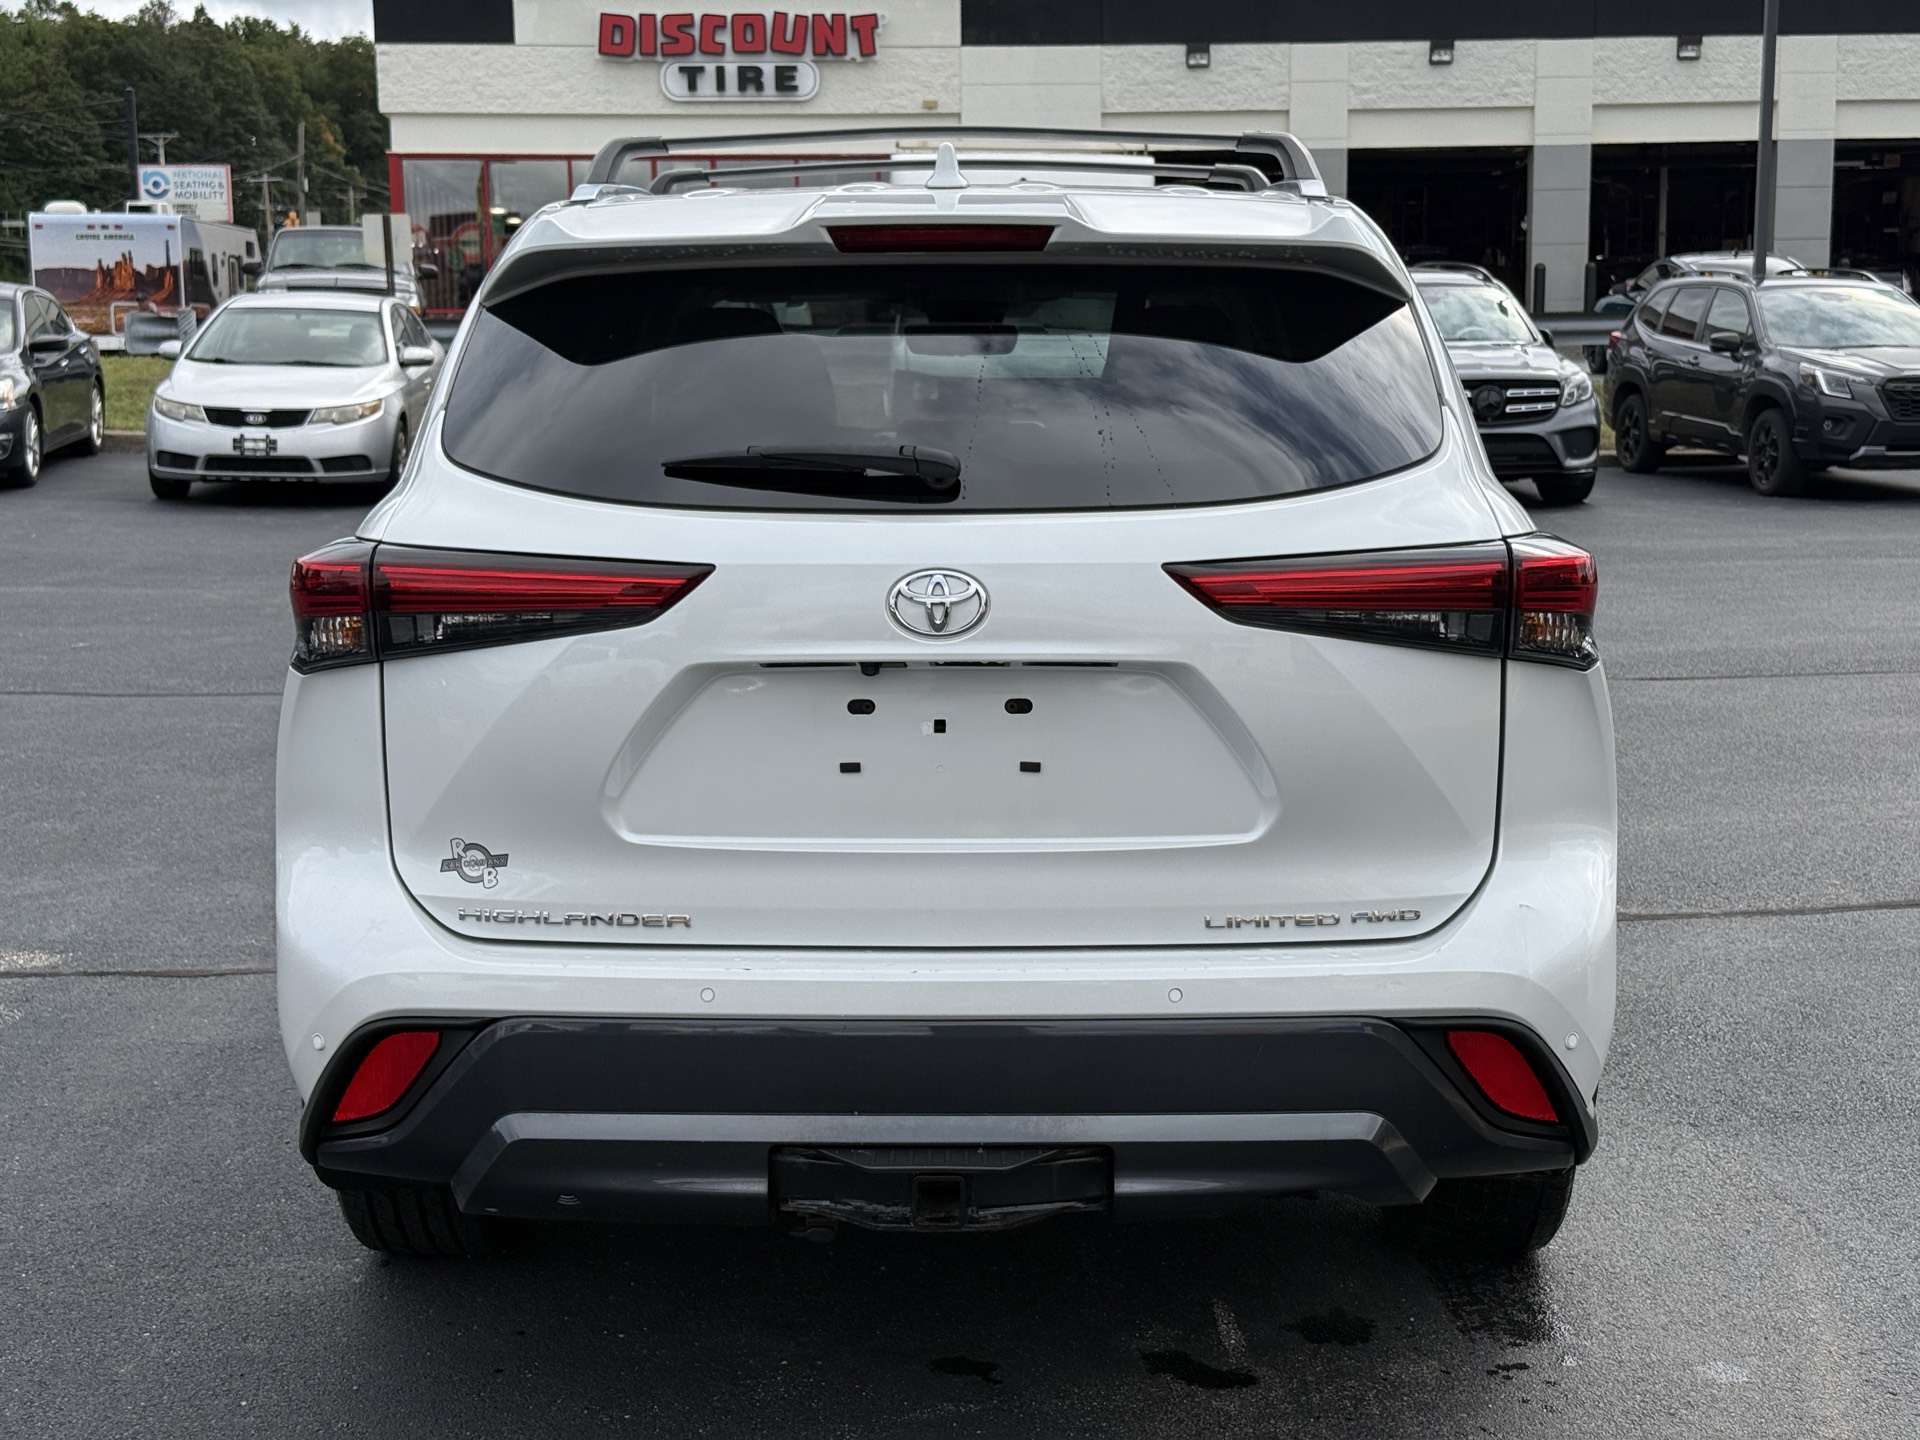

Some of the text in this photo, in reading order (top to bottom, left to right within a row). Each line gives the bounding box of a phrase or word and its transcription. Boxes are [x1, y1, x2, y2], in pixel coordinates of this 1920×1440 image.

[598, 11, 879, 57] DISCOUNT
[678, 65, 799, 93] TIRE
[173, 170, 224, 179] NATIONAL
[173, 181, 216, 190] SEATING
[174, 191, 225, 200] MOBILITY
[458, 907, 692, 928] HIGHLANDER
[1204, 908, 1421, 928] LIMITED AWD
